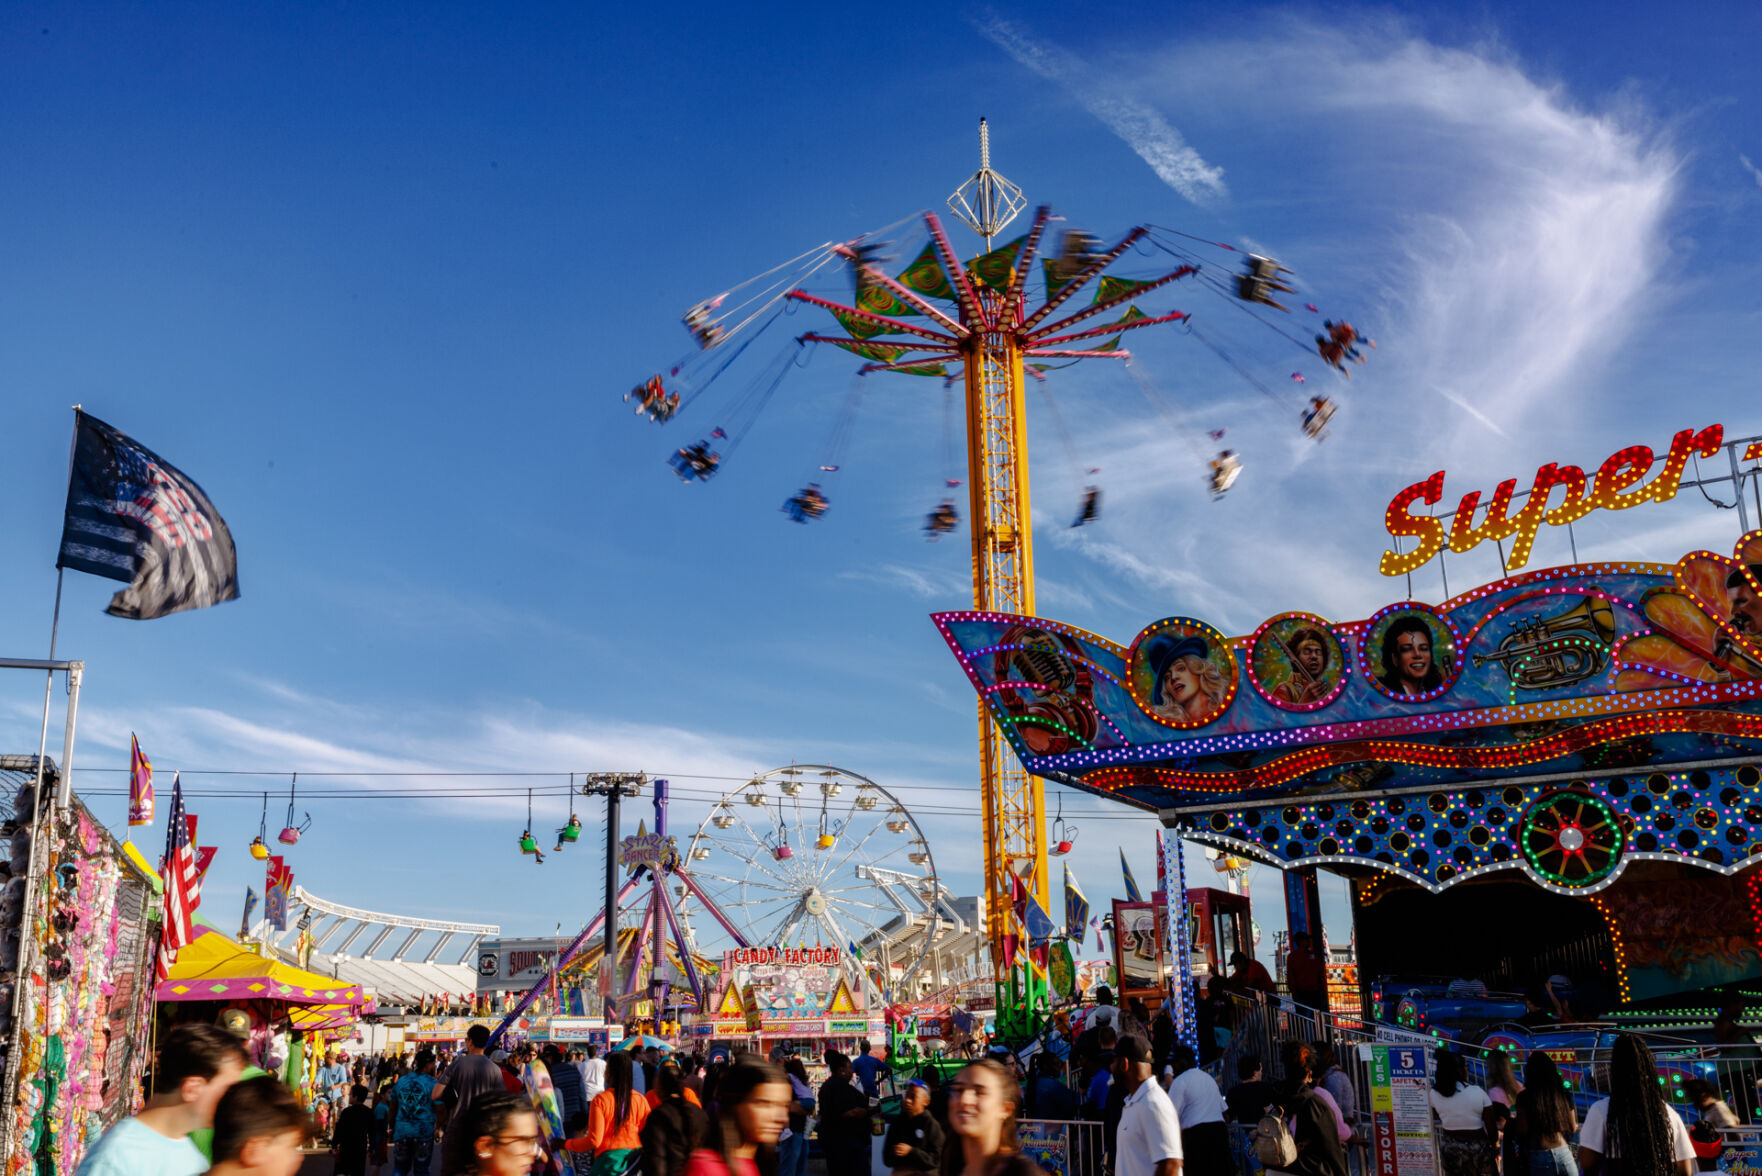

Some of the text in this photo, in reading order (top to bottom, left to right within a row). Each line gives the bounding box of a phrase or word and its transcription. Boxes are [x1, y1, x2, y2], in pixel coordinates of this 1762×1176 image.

[1380, 423, 1724, 576] Super
[624, 834, 660, 852] STAR
[734, 947, 840, 965] CANDY FACTORY
[1383, 1031, 1394, 1042] CELL
[1400, 1051, 1415, 1069] 5
[1544, 1051, 1575, 1062] XIT
[1374, 1055, 1386, 1082] YES
[1724, 1147, 1758, 1160] Super
